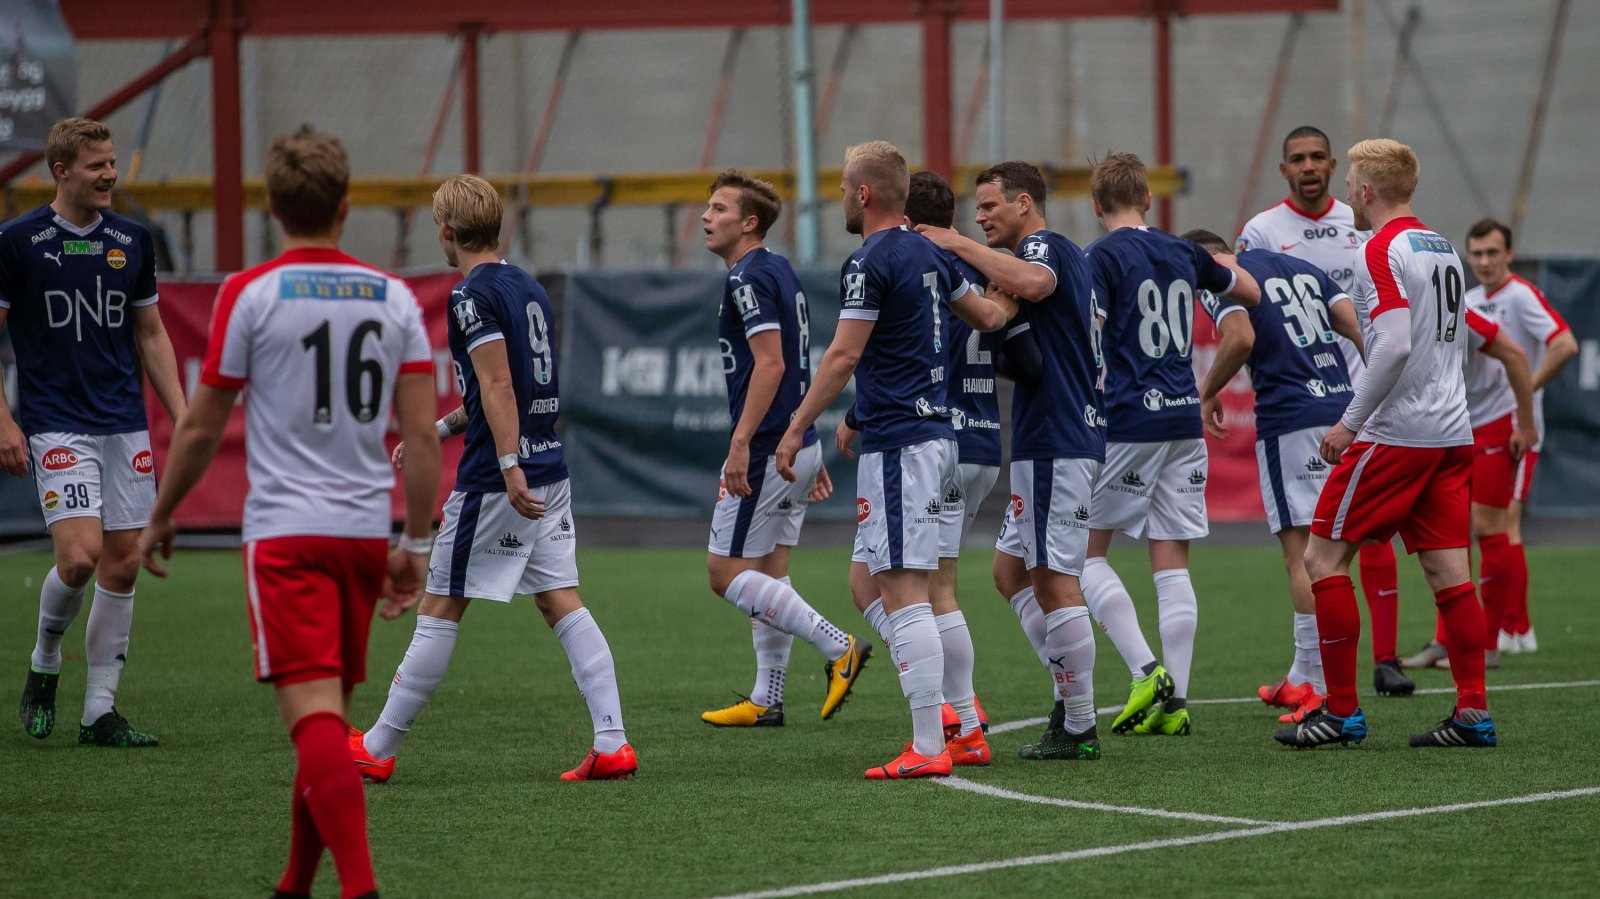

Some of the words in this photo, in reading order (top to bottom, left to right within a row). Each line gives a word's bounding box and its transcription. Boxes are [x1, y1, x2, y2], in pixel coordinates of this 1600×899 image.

[1303, 226, 1338, 240] evo
[44, 275, 127, 342] DNB
[1137, 278, 1195, 359] 80
[1264, 273, 1336, 348] 36
[1431, 263, 1462, 343] 19
[302, 318, 384, 425] 16
[526, 301, 552, 385] 9
[43, 452, 78, 468] ARBO
[63, 483, 90, 509] 39
